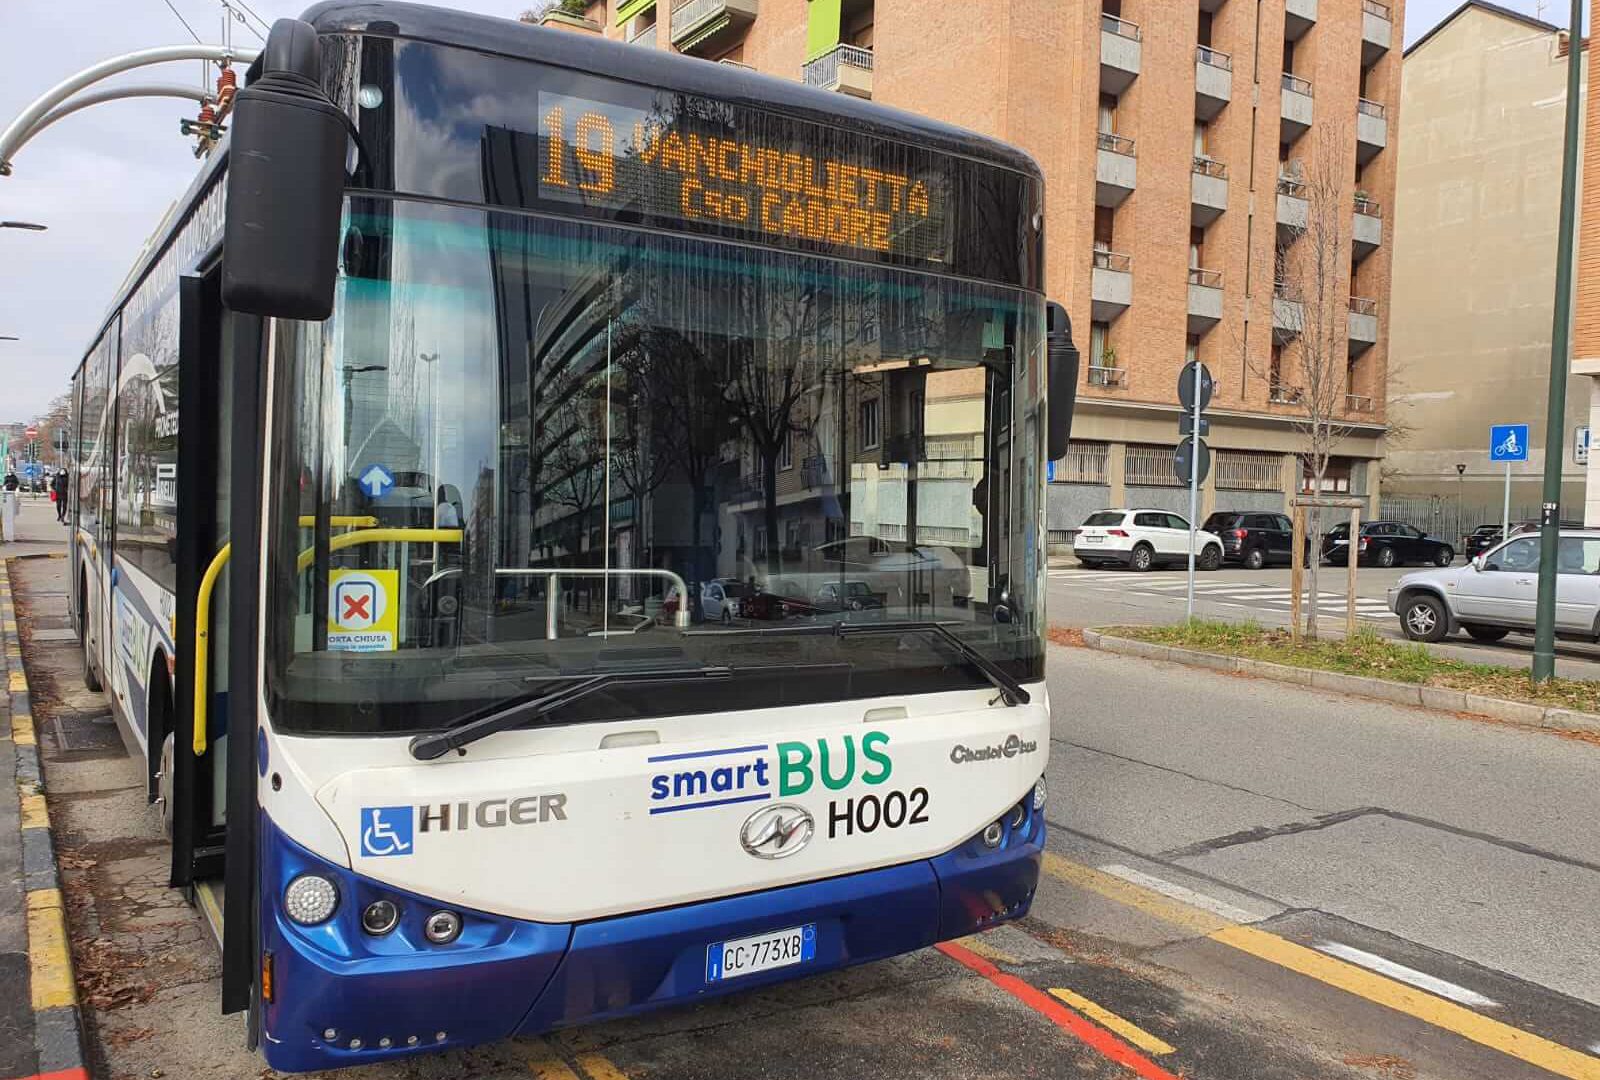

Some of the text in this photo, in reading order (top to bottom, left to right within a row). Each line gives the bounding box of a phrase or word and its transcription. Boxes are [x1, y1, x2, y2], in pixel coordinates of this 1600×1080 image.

[542, 104, 929, 218] 19 VANCHIGLIETTA
[680, 178, 890, 251] Cso CADORE
[328, 635, 387, 643] ORTA CHIUSA
[650, 731, 892, 800] smart BUS
[419, 793, 568, 833] HIGER
[828, 787, 929, 839] H002
